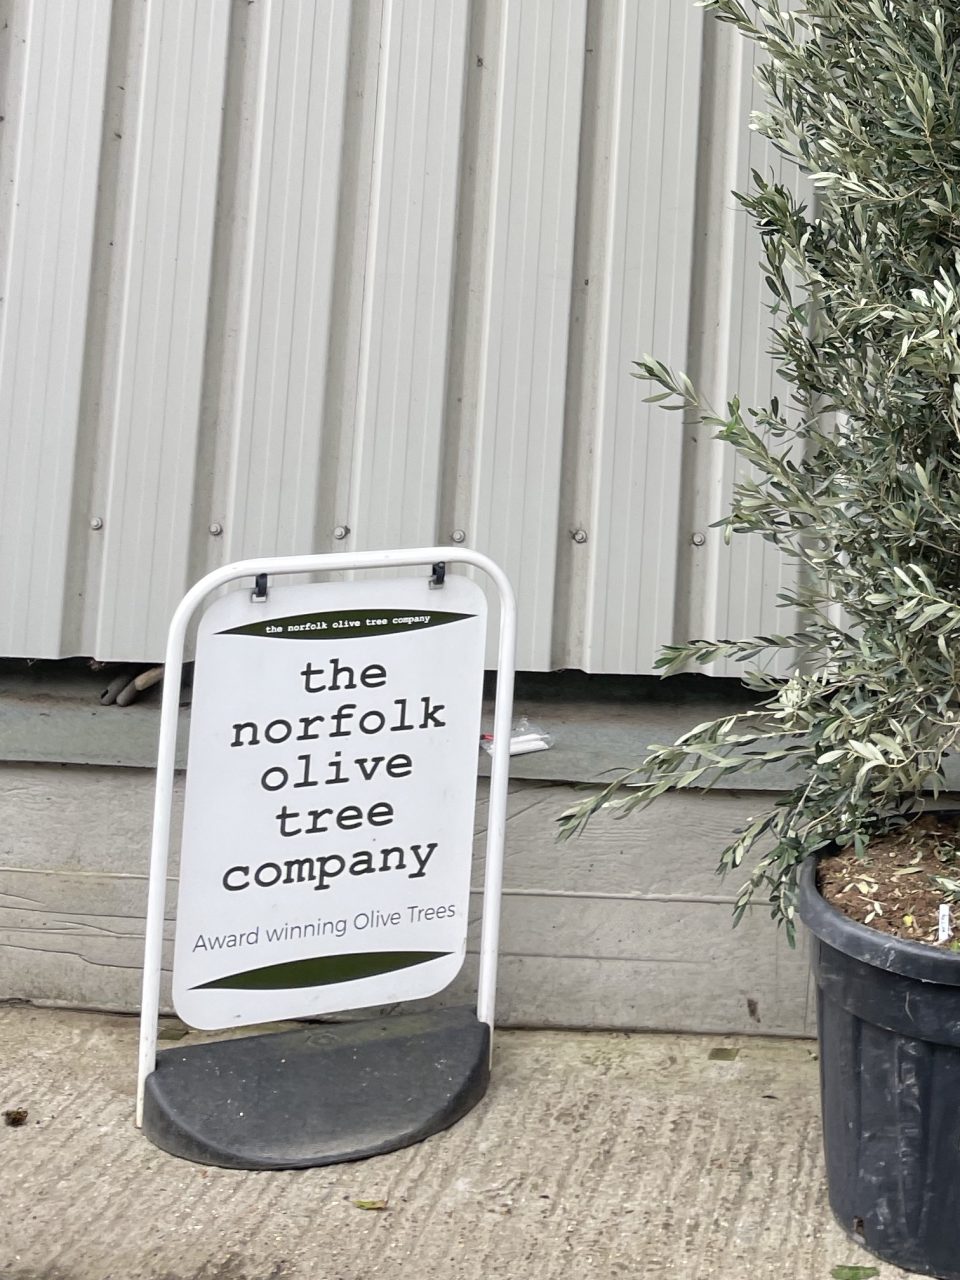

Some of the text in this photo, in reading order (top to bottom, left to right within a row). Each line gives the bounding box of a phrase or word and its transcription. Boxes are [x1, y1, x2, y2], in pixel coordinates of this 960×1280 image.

[265, 616, 431, 634] the norfolk olive tree company
[301, 658, 388, 694] the
[230, 696, 446, 748] norfolk
[260, 750, 413, 792] olive
[275, 801, 394, 838] tree
[222, 842, 438, 892] company
[192, 904, 456, 953] Award winning Olive Trees
